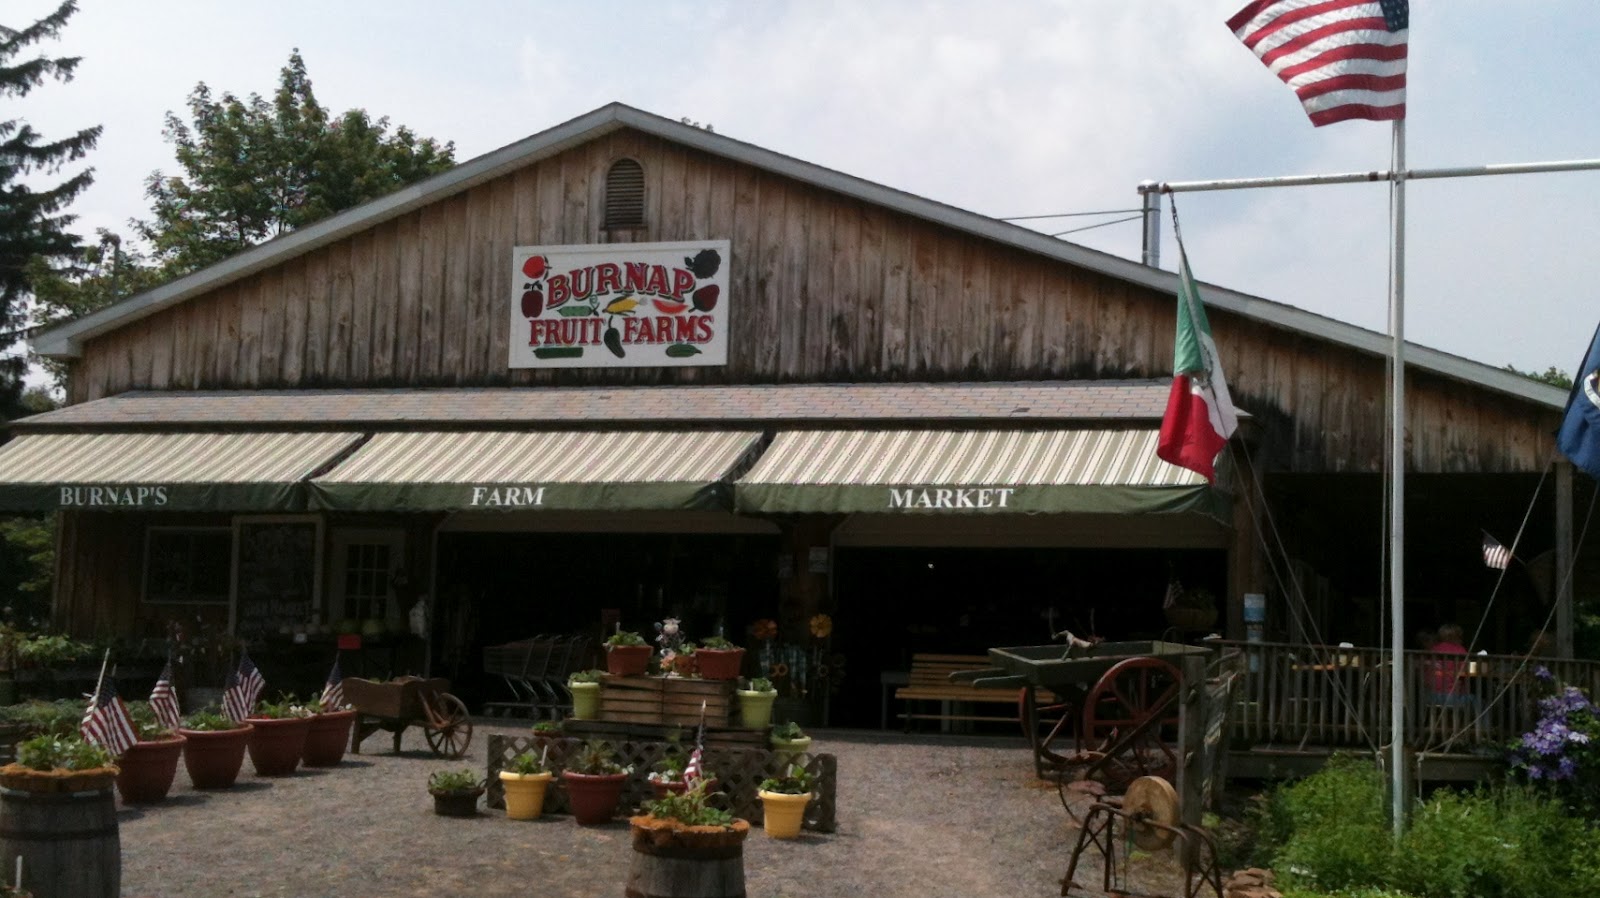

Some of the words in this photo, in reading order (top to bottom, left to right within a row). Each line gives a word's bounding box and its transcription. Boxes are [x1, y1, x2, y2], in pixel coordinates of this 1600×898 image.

[546, 262, 695, 309] BURNAP
[528, 317, 606, 346] FRUIT
[621, 315, 714, 345] FARMS
[60, 486, 168, 506] BURNAP'S
[470, 486, 546, 506] FARM
[887, 488, 1014, 508] MARKET
